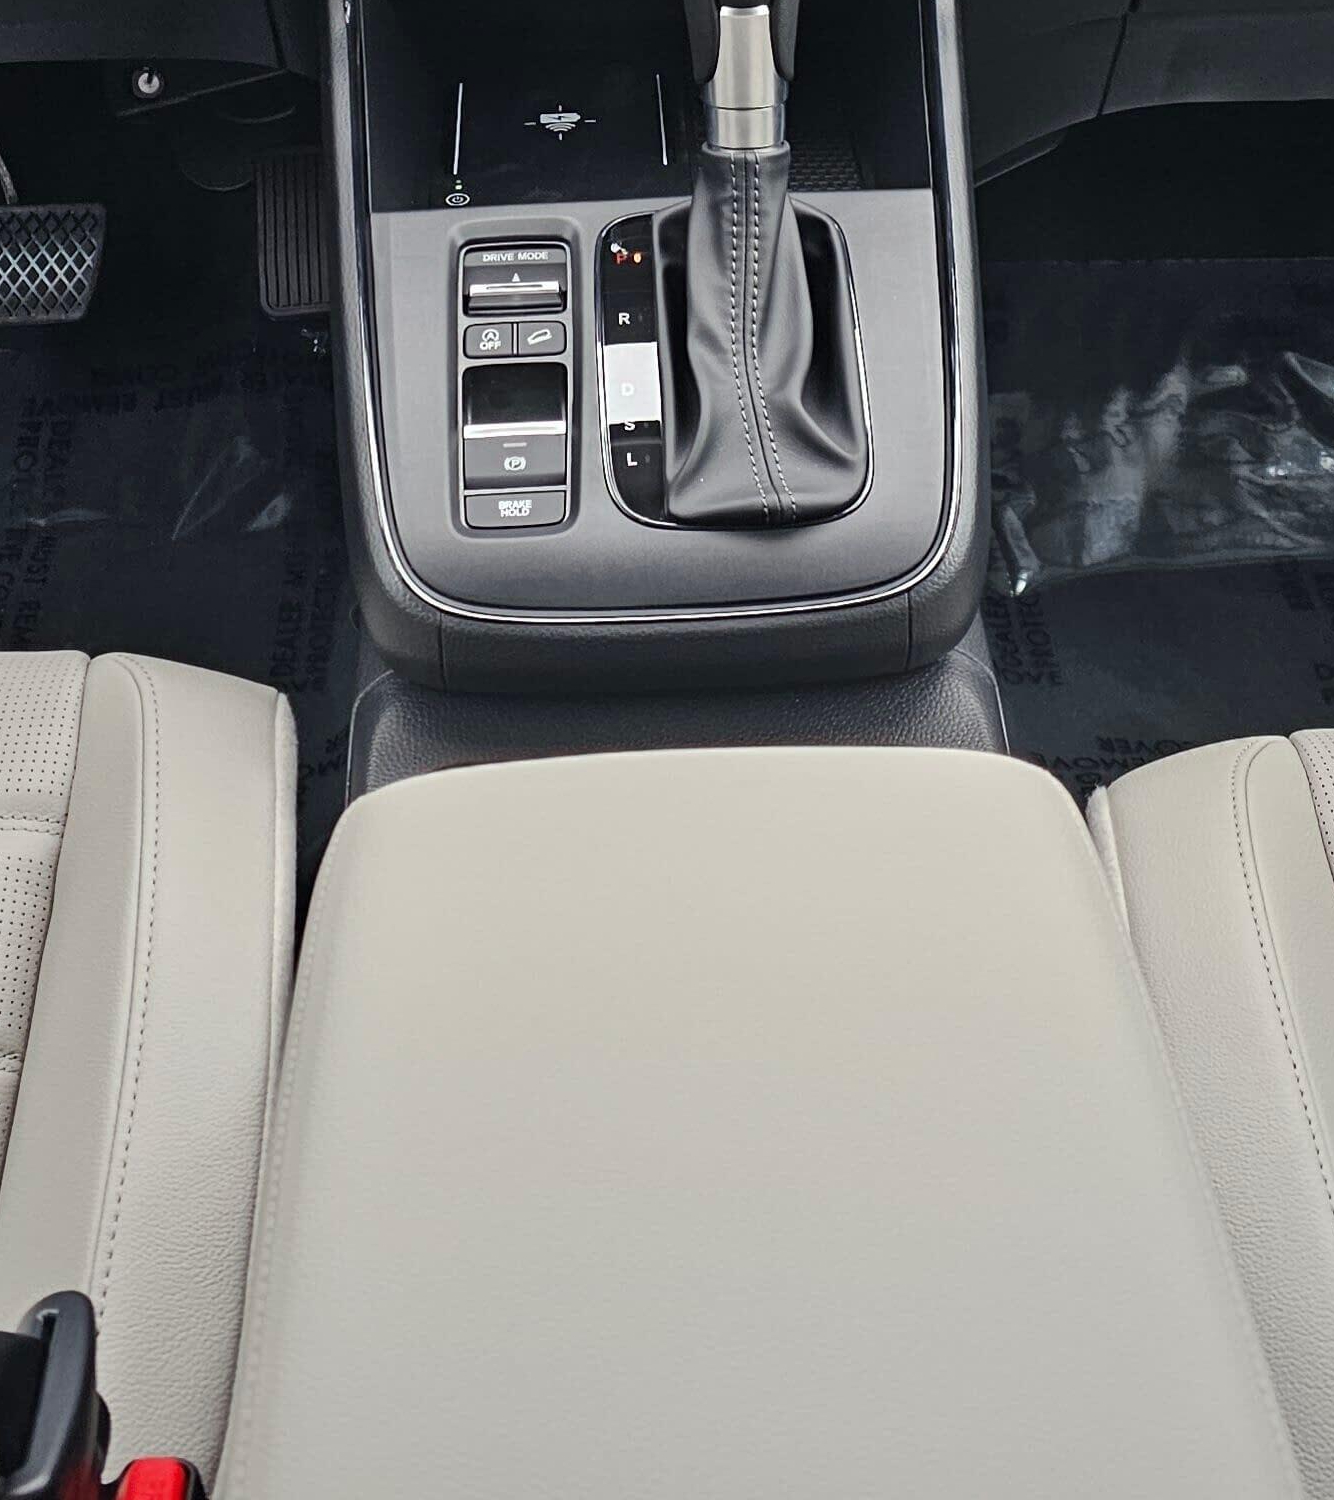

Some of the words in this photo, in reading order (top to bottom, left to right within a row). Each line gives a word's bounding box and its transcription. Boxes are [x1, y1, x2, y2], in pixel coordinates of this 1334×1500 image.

[482, 252, 515, 262] DRIVE
[517, 251, 549, 261] MODE
[618, 312, 631, 325] R
[479, 340, 501, 351] OFF
[620, 381, 635, 397] D
[626, 452, 639, 467] L
[498, 499, 533, 510] BRAKE
[500, 508, 530, 518] HOLD
